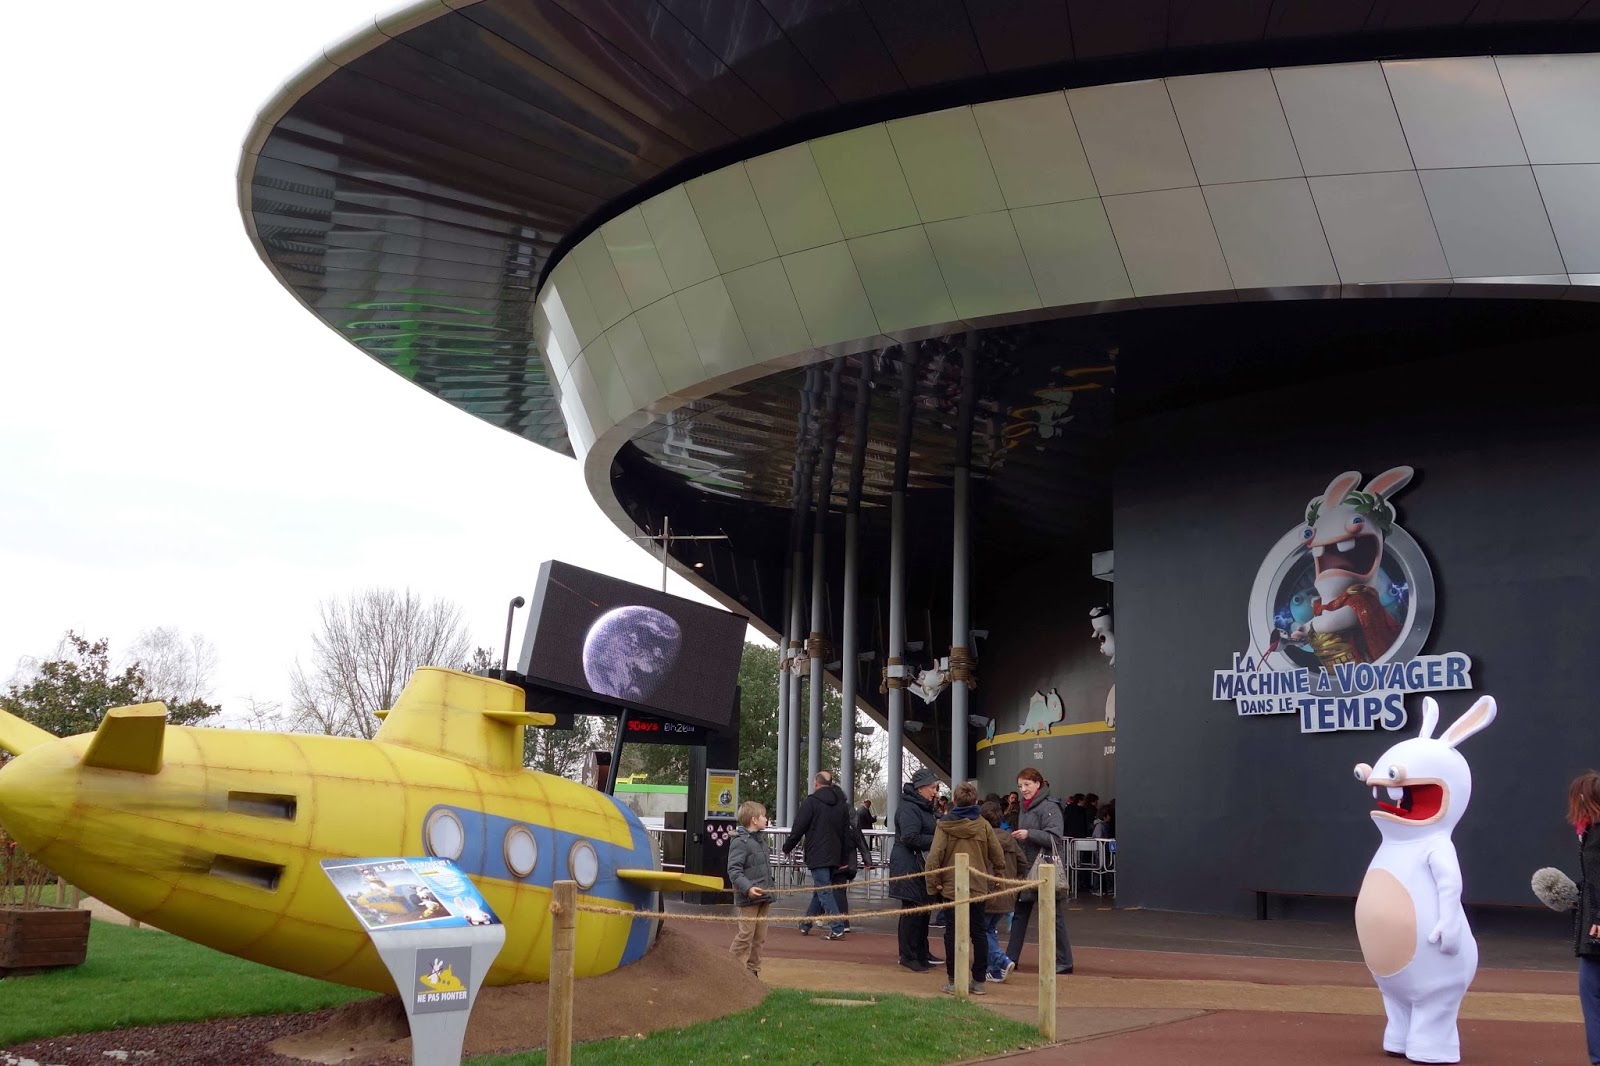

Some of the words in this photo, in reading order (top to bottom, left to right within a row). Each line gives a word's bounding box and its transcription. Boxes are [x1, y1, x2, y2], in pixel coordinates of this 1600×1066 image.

[1216, 669, 1309, 699] MACHINE
[1317, 666, 1331, 692] À
[1334, 656, 1466, 694] VOYAGER
[1236, 656, 1256, 673] LA
[1241, 698, 1274, 714] DANS
[1279, 697, 1294, 712] LE
[1298, 693, 1404, 730] TEMPS
[417, 993, 427, 1003] NE
[427, 992, 440, 1002] PAS
[441, 990, 468, 1001] MONTER
